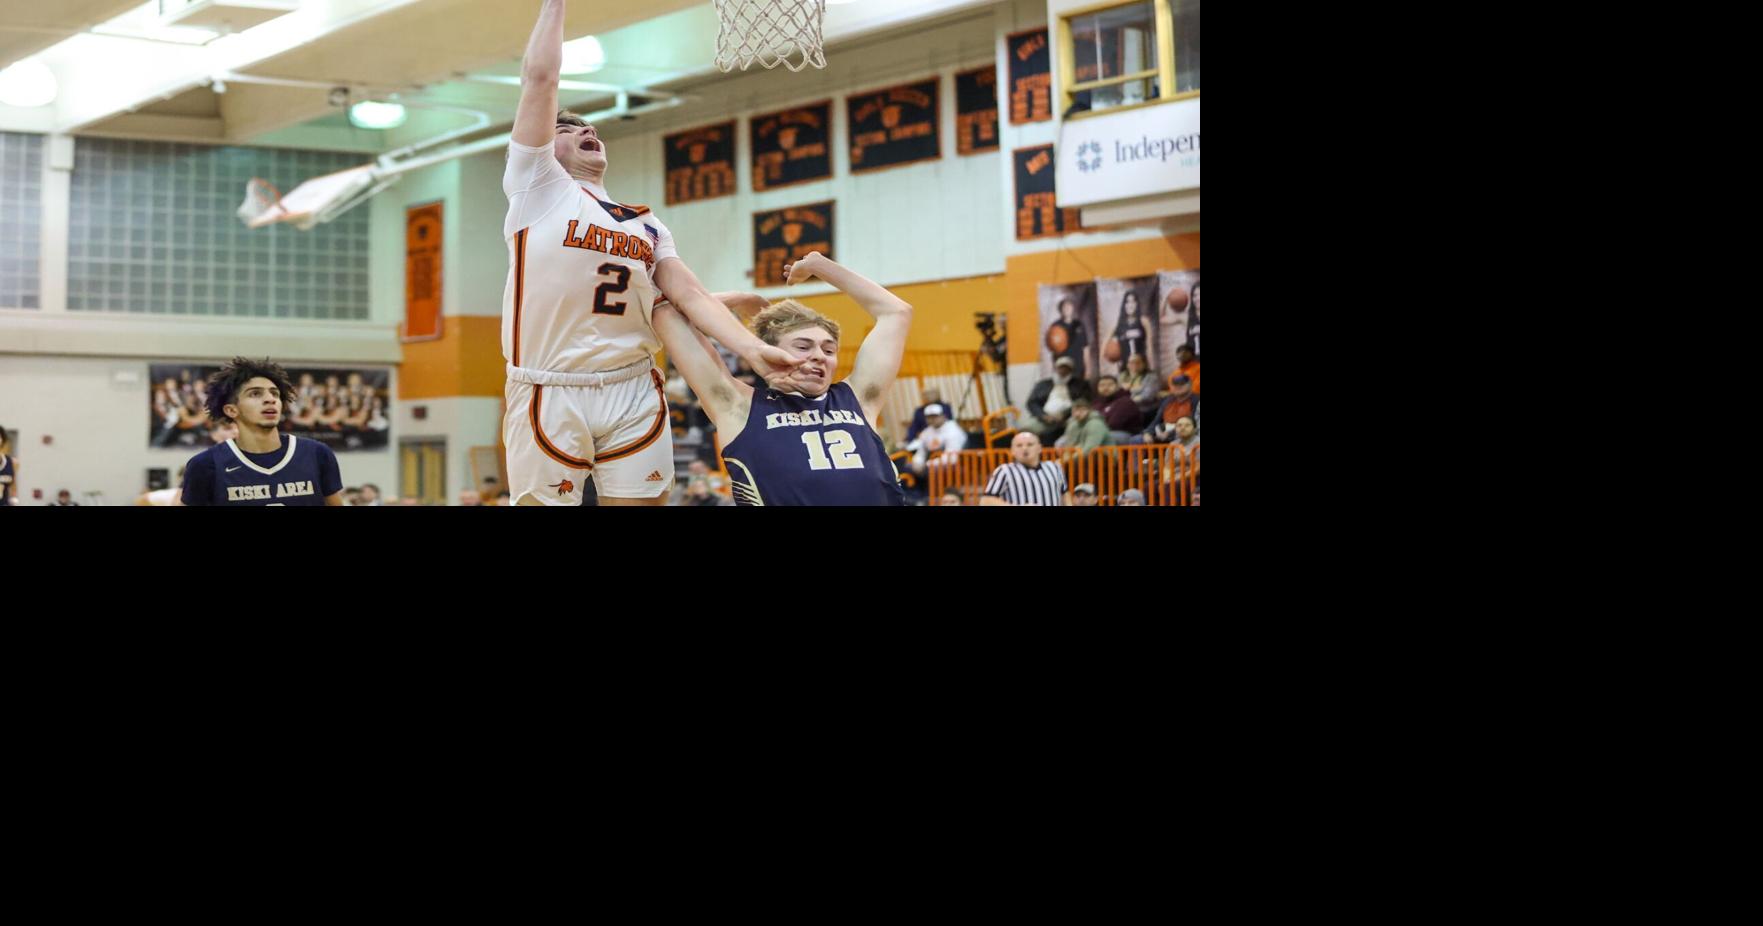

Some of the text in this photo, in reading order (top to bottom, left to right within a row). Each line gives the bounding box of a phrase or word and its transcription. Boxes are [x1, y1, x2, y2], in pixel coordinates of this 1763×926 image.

[591, 262, 631, 316] 2
[766, 409, 865, 430] KISKI AREA
[801, 430, 865, 470] 12
[227, 480, 315, 501] KISKI AREA
